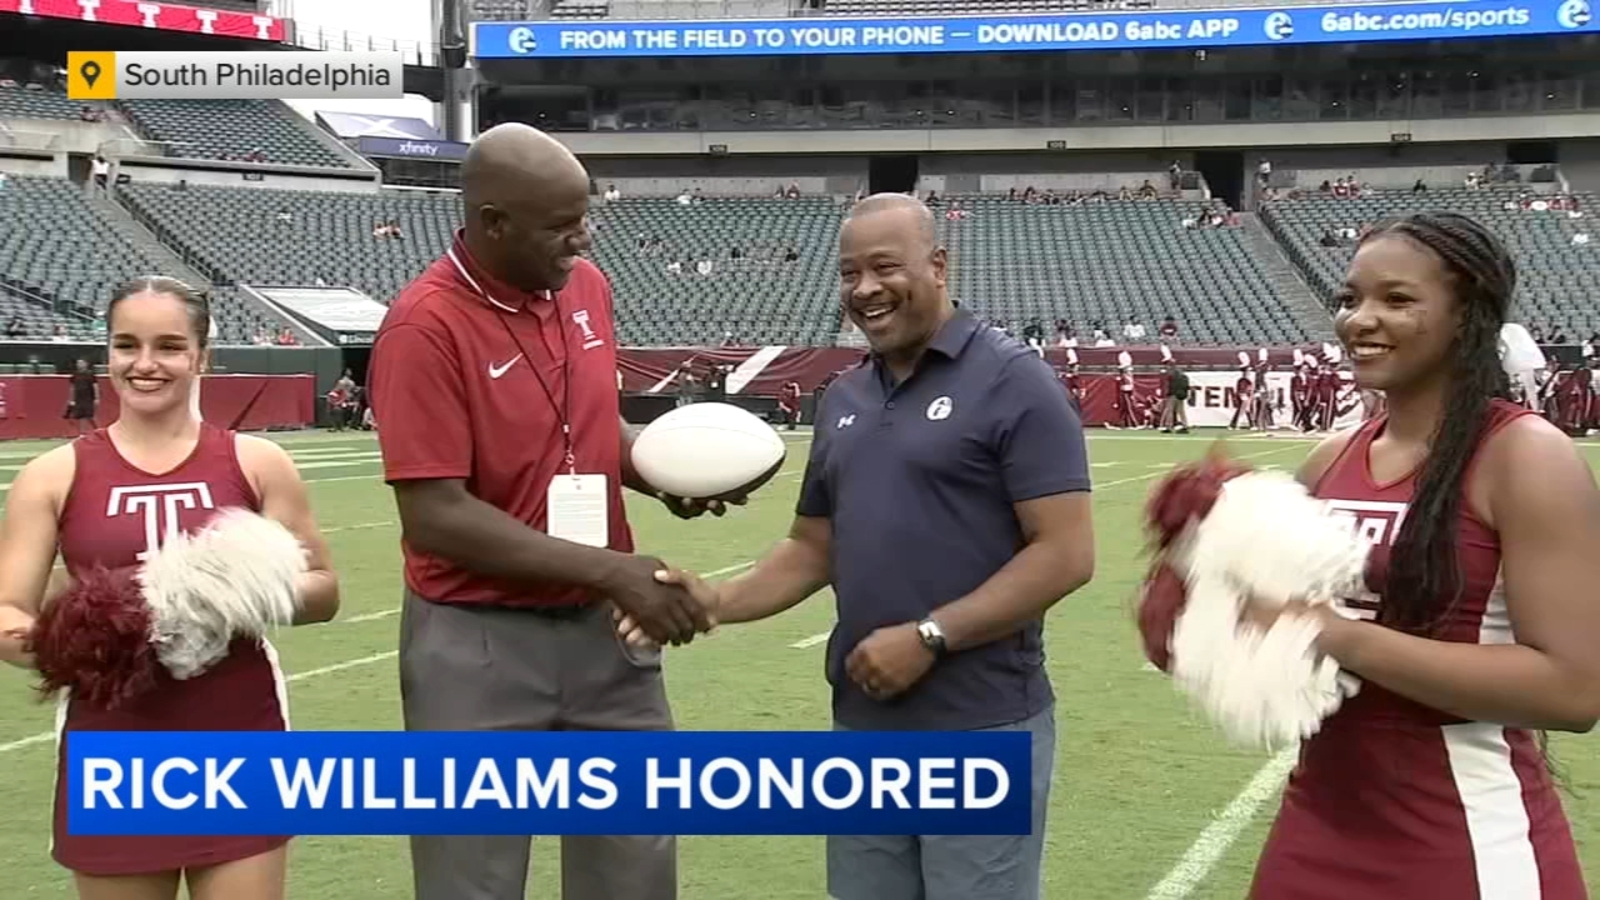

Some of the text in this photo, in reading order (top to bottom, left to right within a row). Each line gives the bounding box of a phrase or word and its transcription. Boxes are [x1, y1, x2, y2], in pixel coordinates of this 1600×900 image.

[560, 30, 626, 49] FROM
[632, 29, 678, 48] THE
[684, 29, 746, 48] FIELD
[753, 28, 785, 46] TO
[791, 27, 855, 46] YOUR
[862, 25, 944, 45] PHONE
[978, 22, 1118, 43] DOWNLOAD
[1124, 20, 1181, 41] 6abc
[1187, 18, 1239, 38] APP
[1321, 6, 1529, 32] 6abc.com/sports
